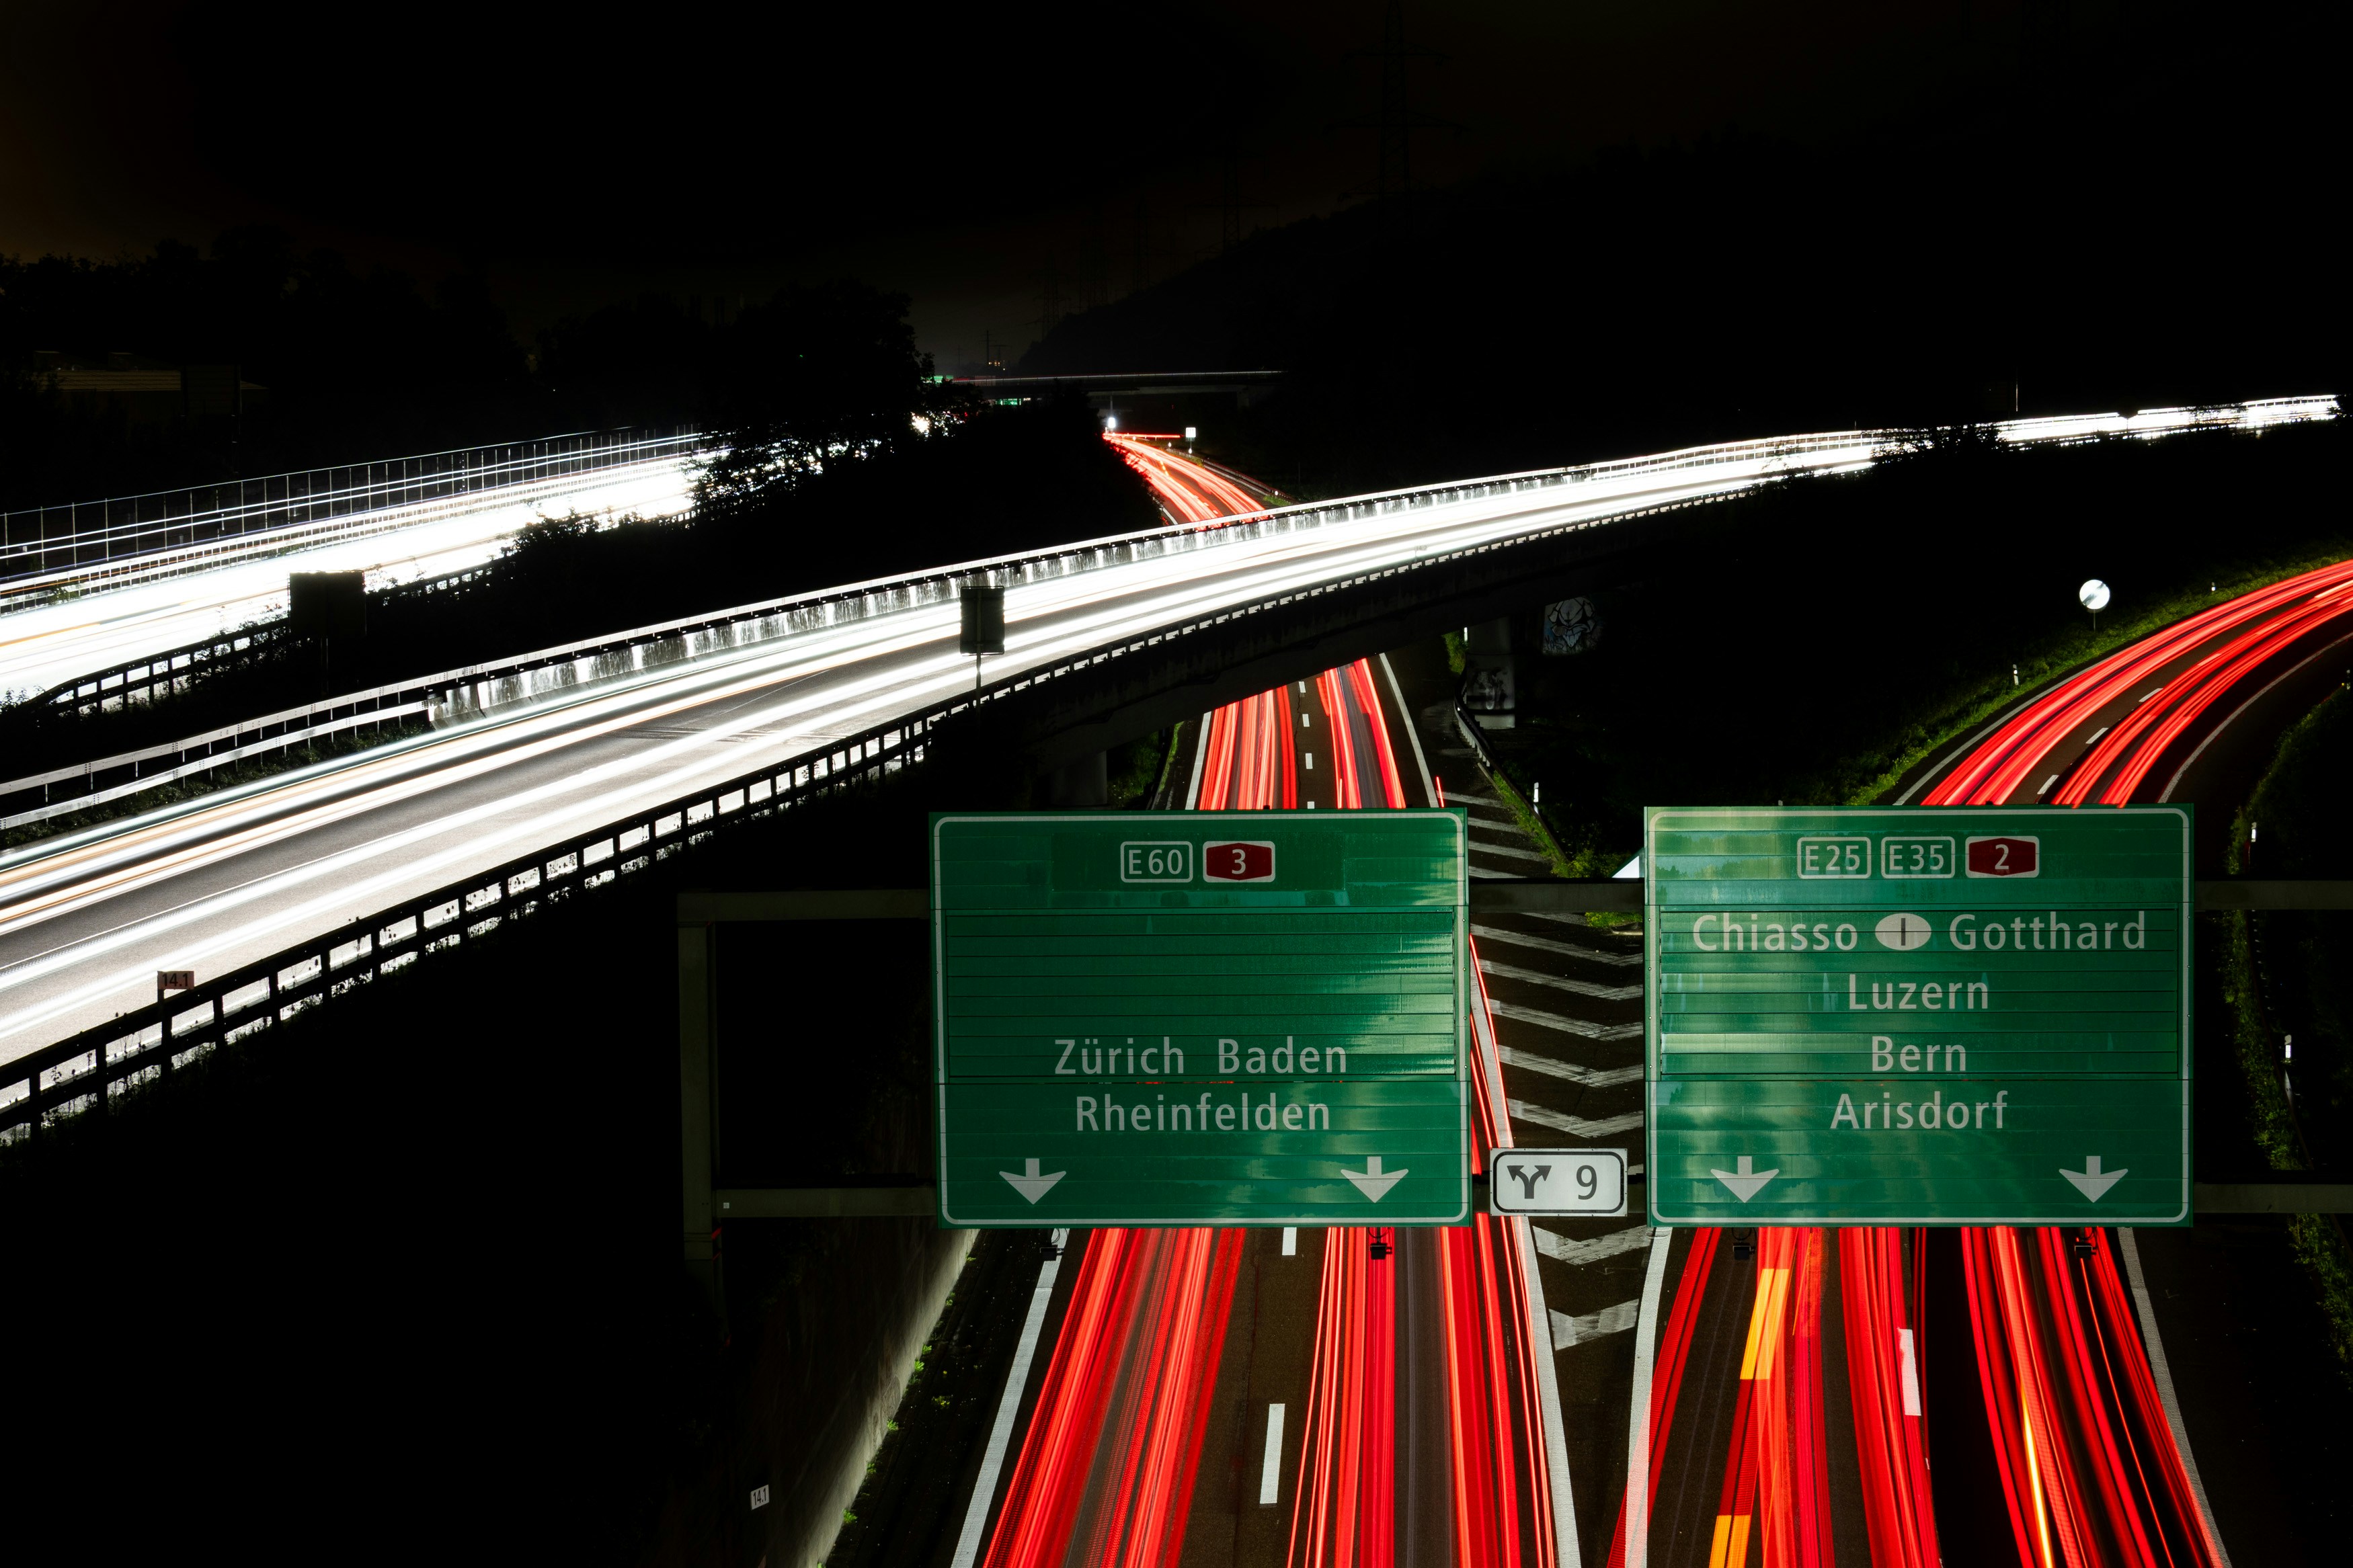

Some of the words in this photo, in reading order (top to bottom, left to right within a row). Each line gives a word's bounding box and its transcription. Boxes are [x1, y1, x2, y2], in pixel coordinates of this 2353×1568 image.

[1129, 850, 1183, 874] E60
[1232, 849, 1246, 874] 3
[1806, 845, 1860, 870] E25
[1889, 845, 1944, 870] E35
[1995, 844, 2009, 870] 2
[1693, 913, 1858, 951] Chiasso
[1950, 911, 2145, 950] Gotthard
[163, 973, 188, 987] 14.1
[1849, 975, 1989, 1009] Luzern
[1055, 1037, 1184, 1074] Zürich
[1218, 1036, 1347, 1074] Baden
[1872, 1036, 1966, 1071] Bern
[1077, 1092, 1329, 1131] Rheinfelden
[1830, 1090, 2008, 1129] Arisdorf
[1577, 1165, 1597, 1200] 9
[754, 1487, 766, 1505] 14.1
